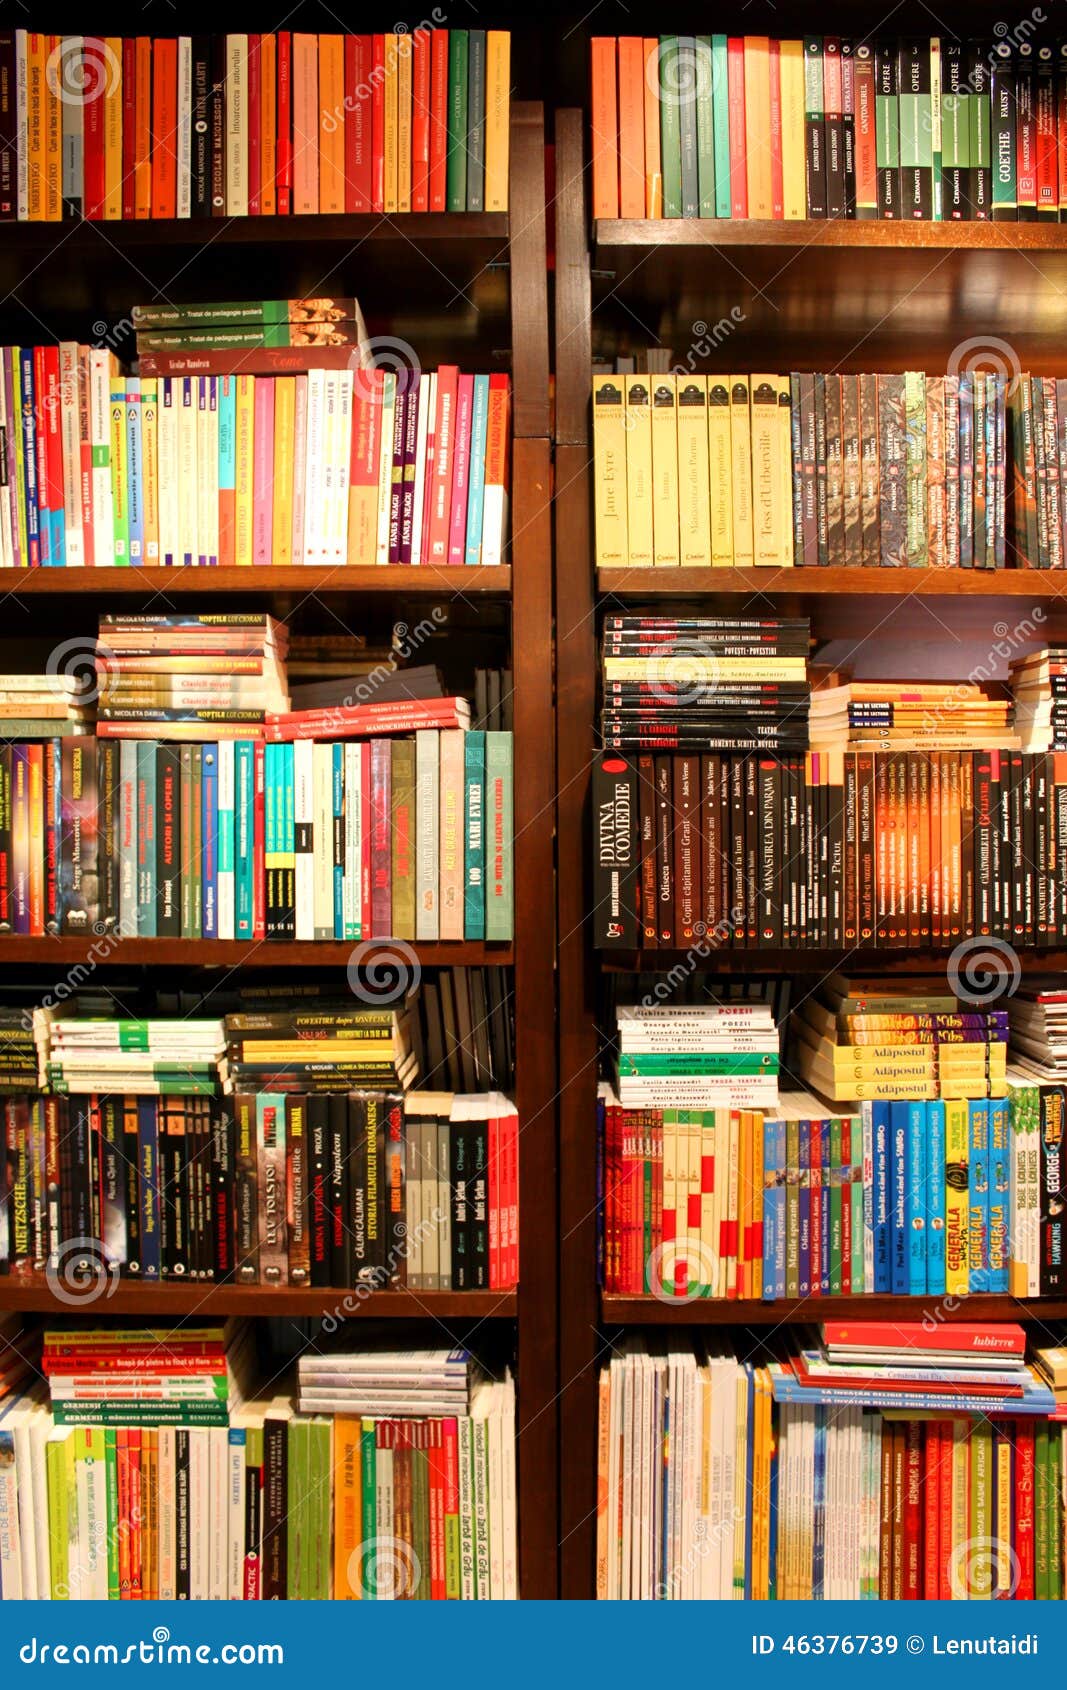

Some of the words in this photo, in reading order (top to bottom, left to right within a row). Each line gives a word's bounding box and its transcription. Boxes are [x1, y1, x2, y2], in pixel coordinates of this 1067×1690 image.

[1000, 132, 1011, 182] GOETHE
[600, 801, 614, 861] DIVINA
[615, 784, 630, 861] COMEDIE
[291, 1107, 302, 1136] JURNAL
[293, 1148, 301, 1173] Rilke
[333, 1133, 344, 1185] Napoleon
[367, 1155, 377, 1200] FILMULUI
[1047, 1153, 1060, 1193] GEORGE
[293, 1177, 301, 1205] Maria
[14, 1183, 28, 1253] NIETZSCHE
[294, 1209, 302, 1241] Rainer
[367, 1201, 377, 1239] ISTORIA
[1052, 1223, 1061, 1265] HAWKING
